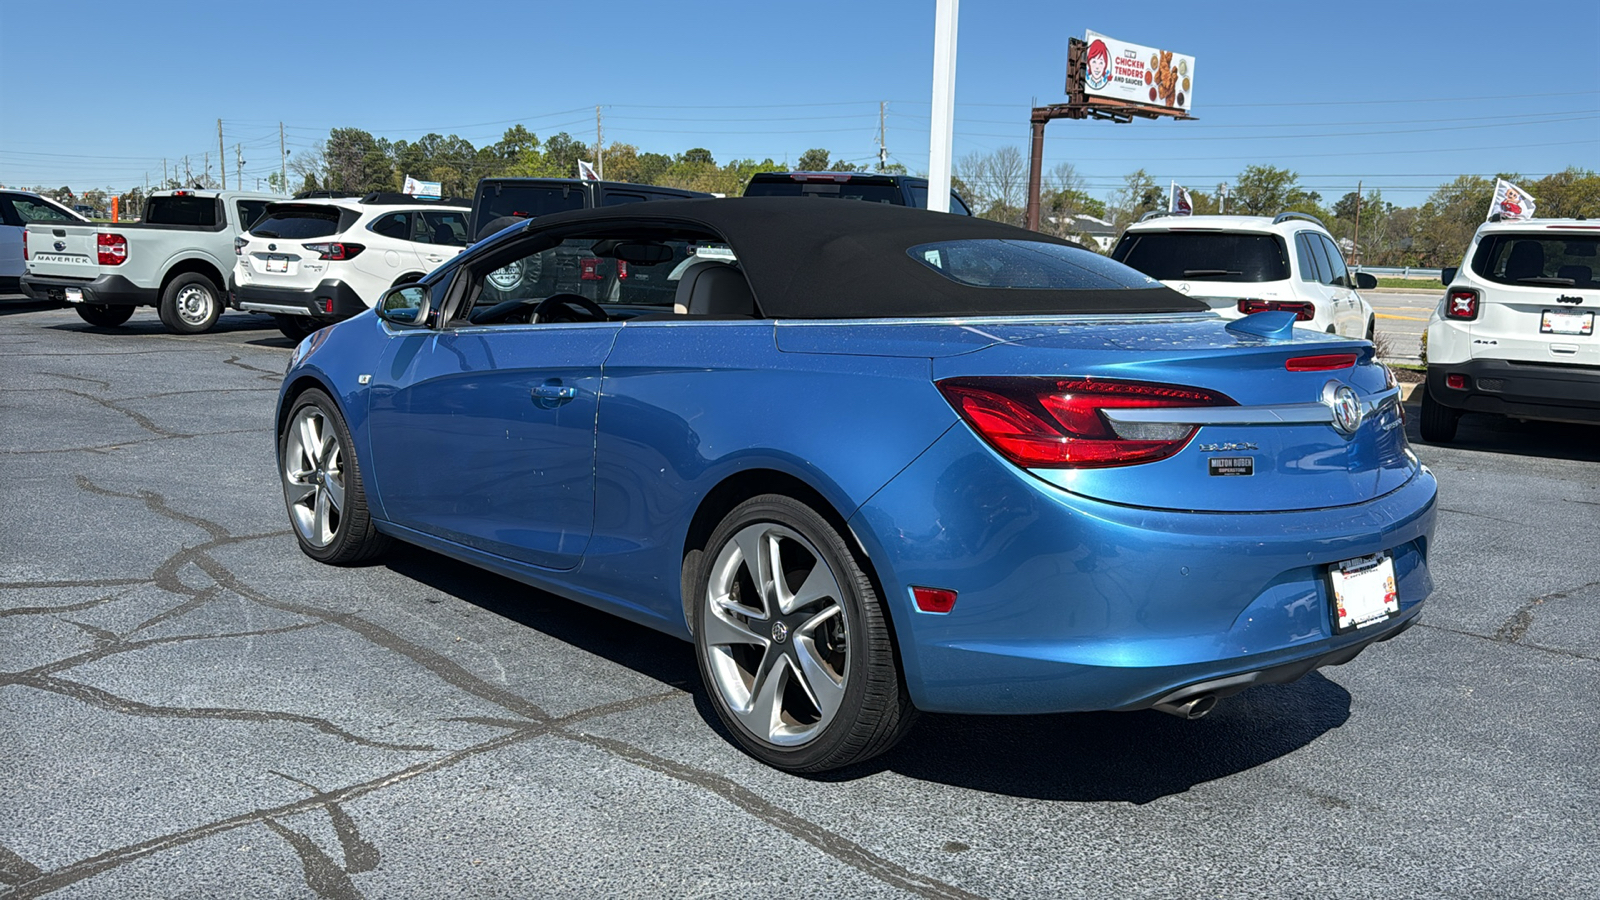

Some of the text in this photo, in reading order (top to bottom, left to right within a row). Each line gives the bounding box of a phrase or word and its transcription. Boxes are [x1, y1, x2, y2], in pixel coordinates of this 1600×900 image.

[1115, 56, 1145, 69] CHICKEN
[1114, 66, 1143, 79] TENDERS
[1125, 77, 1143, 86] SAUCES
[37, 255, 88, 263] MAVERICK
[1556, 294, 1583, 305] Jeep
[1199, 442, 1259, 452] BUICK
[1211, 459, 1252, 467] MILTON RUBEN
